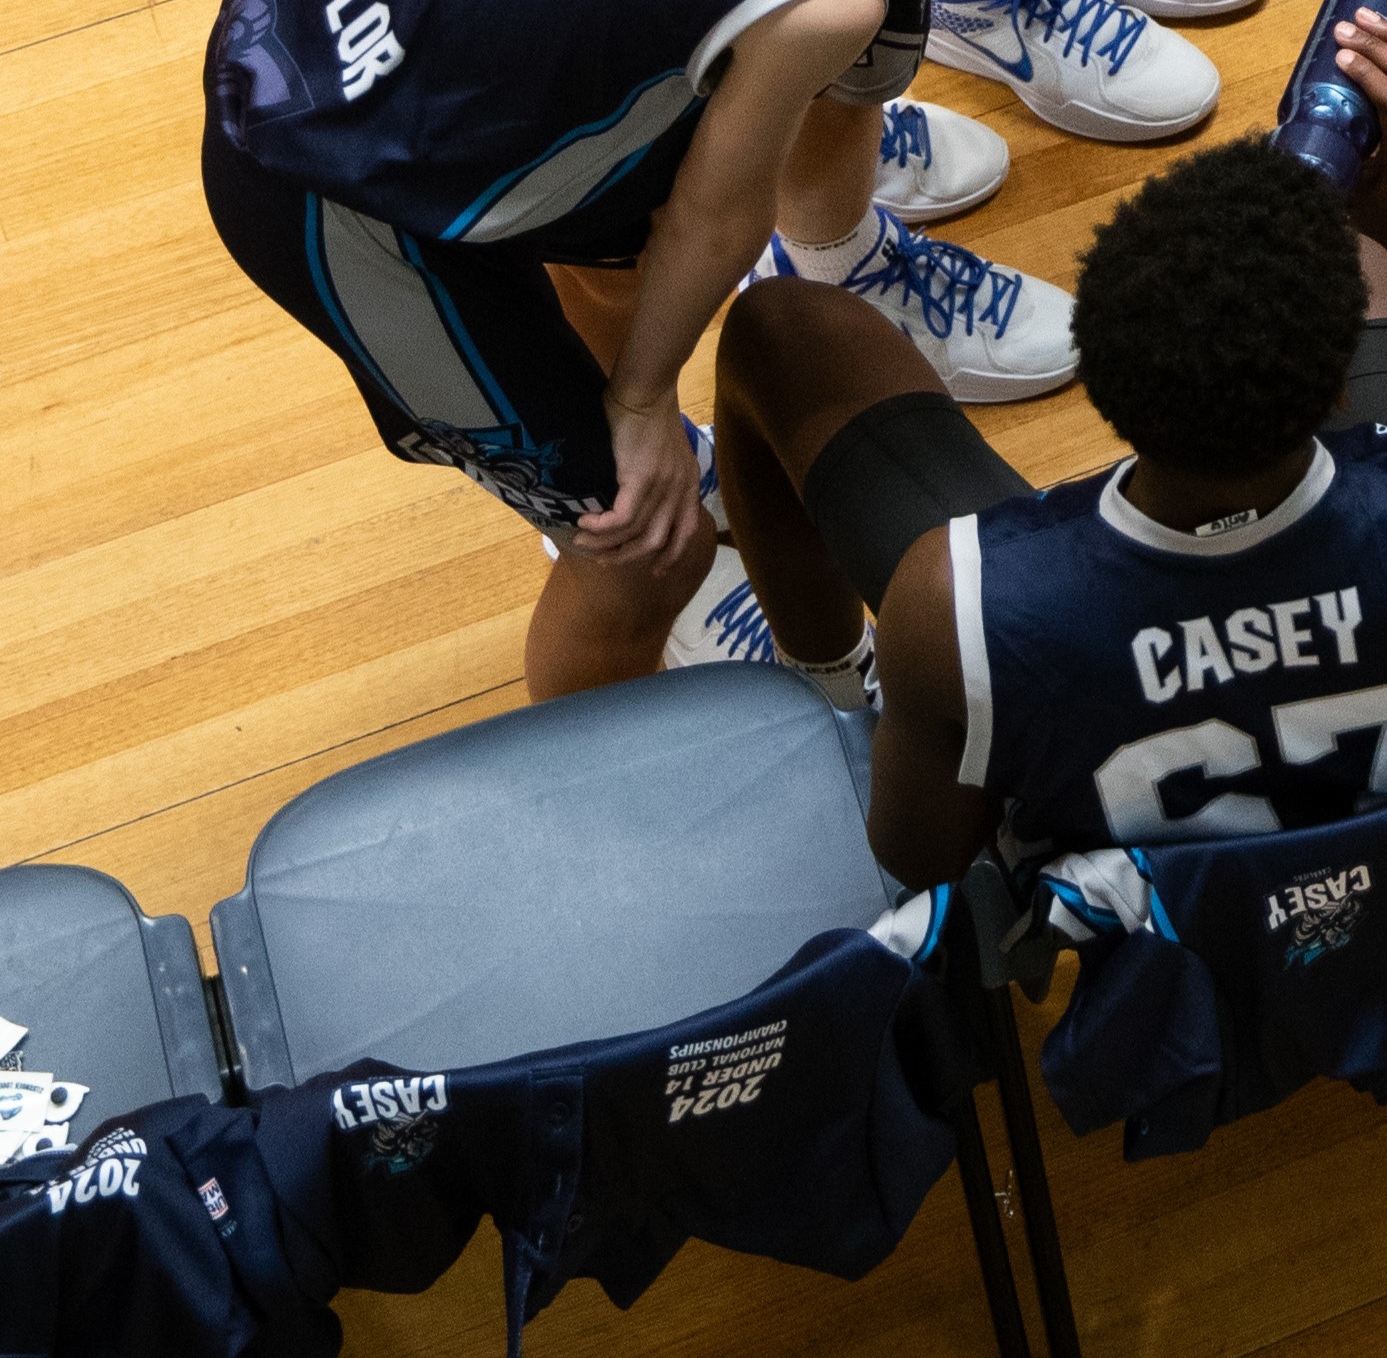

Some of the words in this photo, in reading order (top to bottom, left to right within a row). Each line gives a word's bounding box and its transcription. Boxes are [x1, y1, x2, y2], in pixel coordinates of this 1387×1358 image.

[1132, 585, 1364, 704] CASEY
[1268, 864, 1371, 930] CASEY
[669, 1020, 787, 1060] CHAMPIONSHIPS
[712, 1035, 786, 1067] NATIONAL
[665, 1075, 694, 1096] 14
[667, 1058, 707, 1076] CLUB
[702, 1052, 782, 1086] UNDER
[333, 1074, 448, 1130] CASEY
[669, 1073, 767, 1123] 2024
[46, 1158, 142, 1215] 2024
